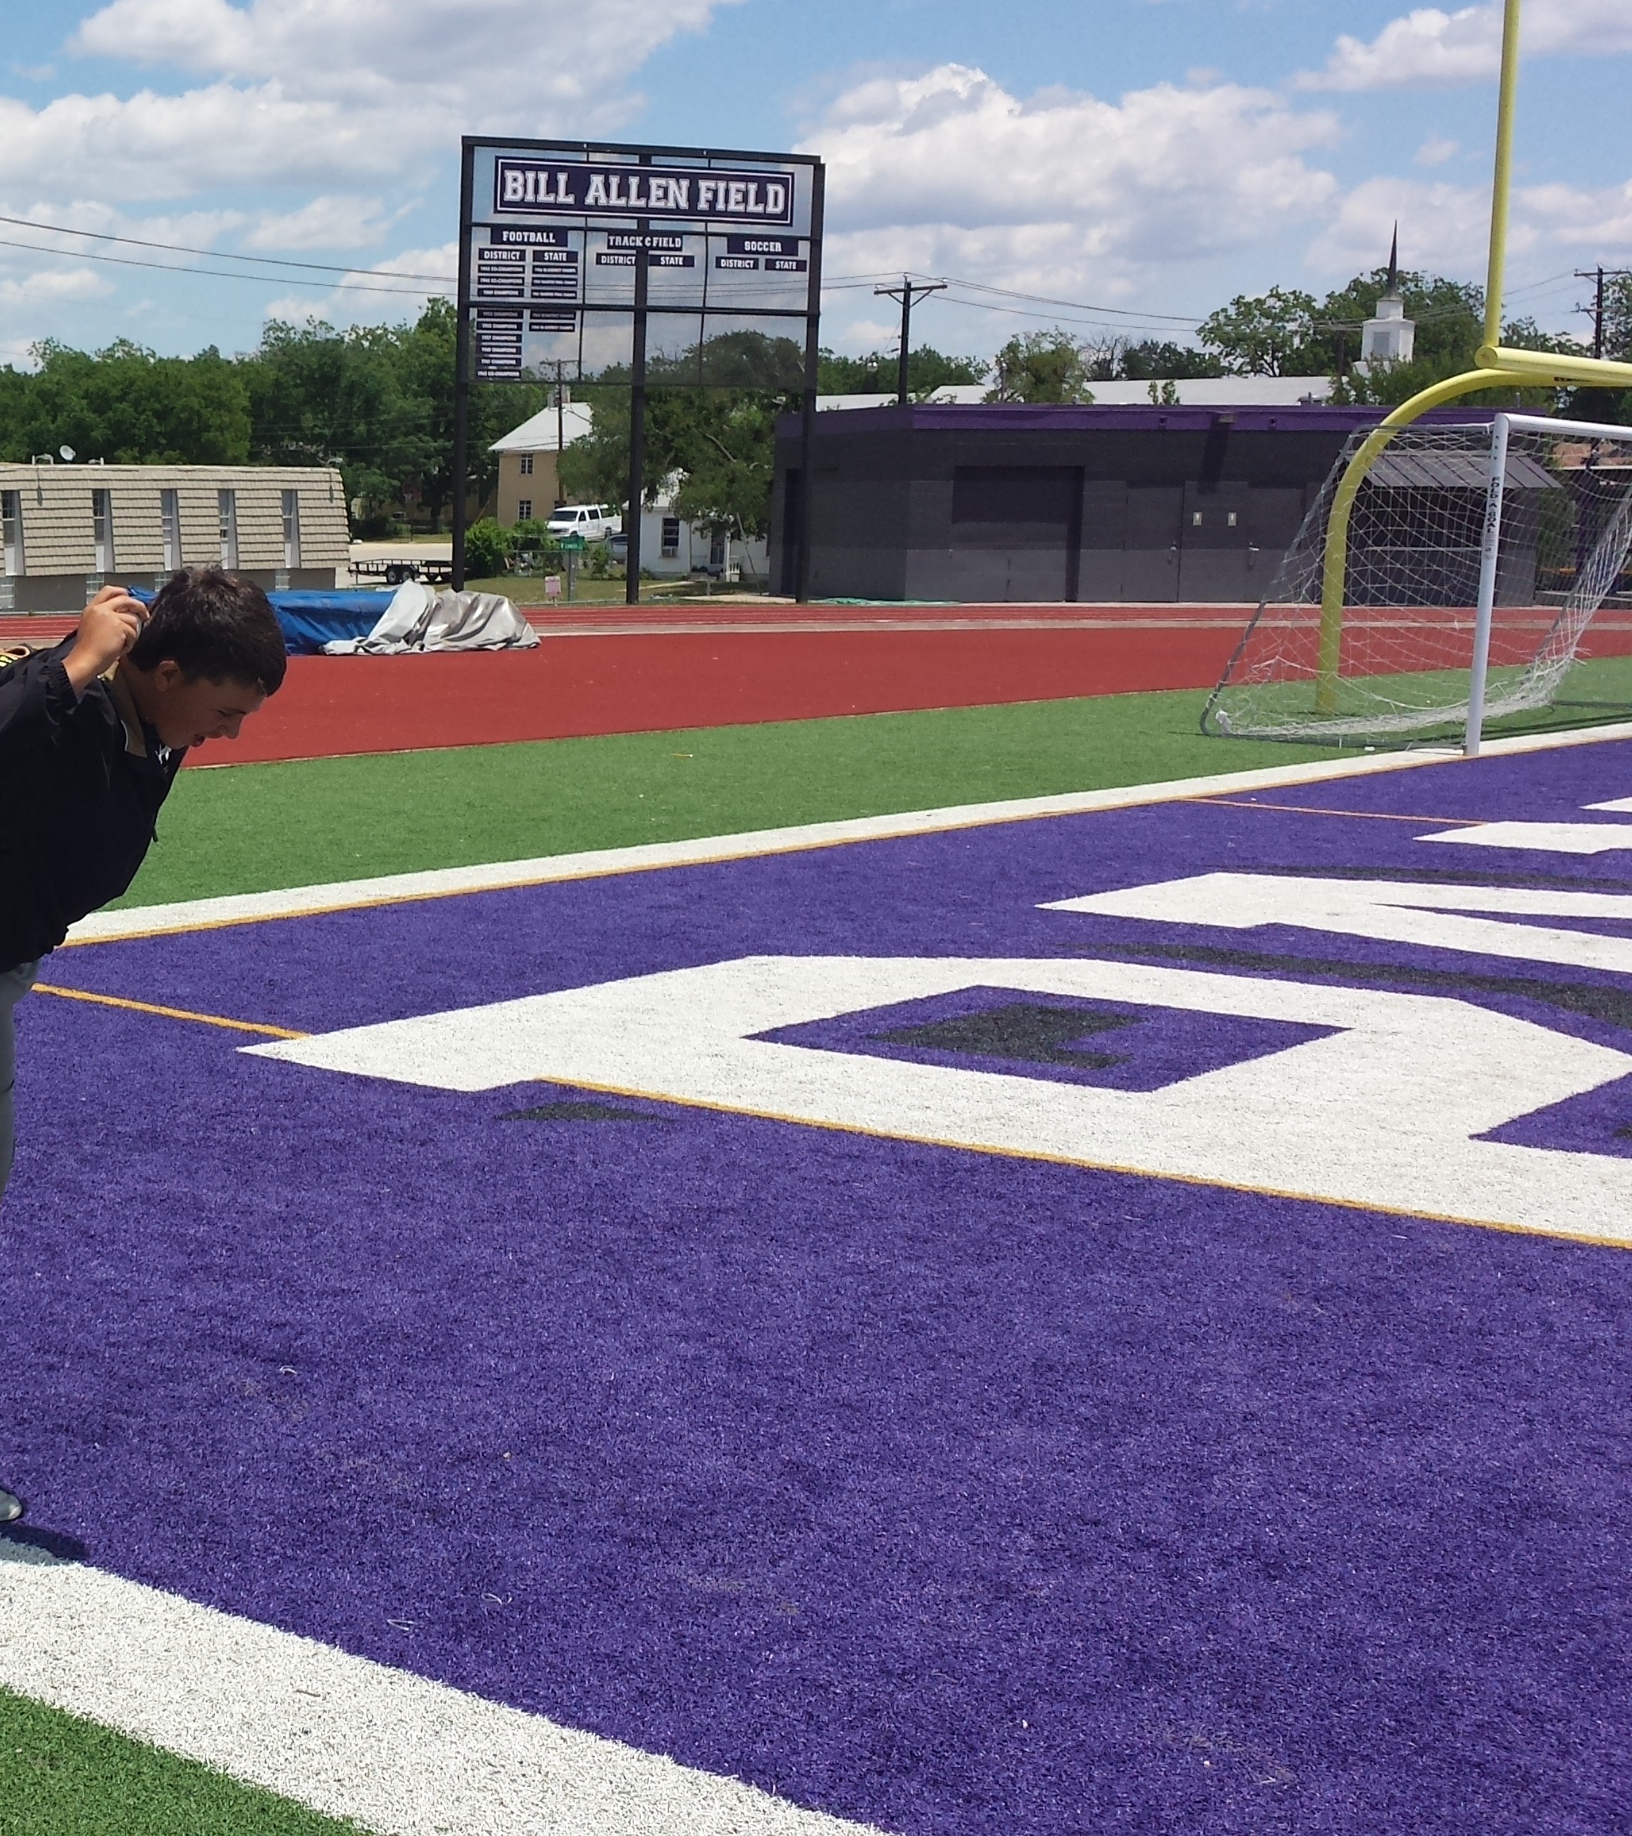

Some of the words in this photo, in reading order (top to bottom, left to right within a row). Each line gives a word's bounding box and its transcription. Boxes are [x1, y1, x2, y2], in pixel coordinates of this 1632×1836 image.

[504, 170, 575, 204] BILL
[584, 174, 690, 210] ALLEN
[697, 179, 786, 214] FIELD
[502, 231, 556, 244] FOOTBALL
[608, 236, 642, 247] TRACK
[652, 238, 682, 248] FIELD
[744, 241, 782, 252] SOCCER
[484, 250, 520, 260] DISTRICT
[544, 252, 567, 261] STATE
[601, 256, 636, 265] DISTRICT
[660, 257, 683, 266] STATE
[720, 259, 754, 268] DISTRICT
[775, 261, 797, 270] STATE
